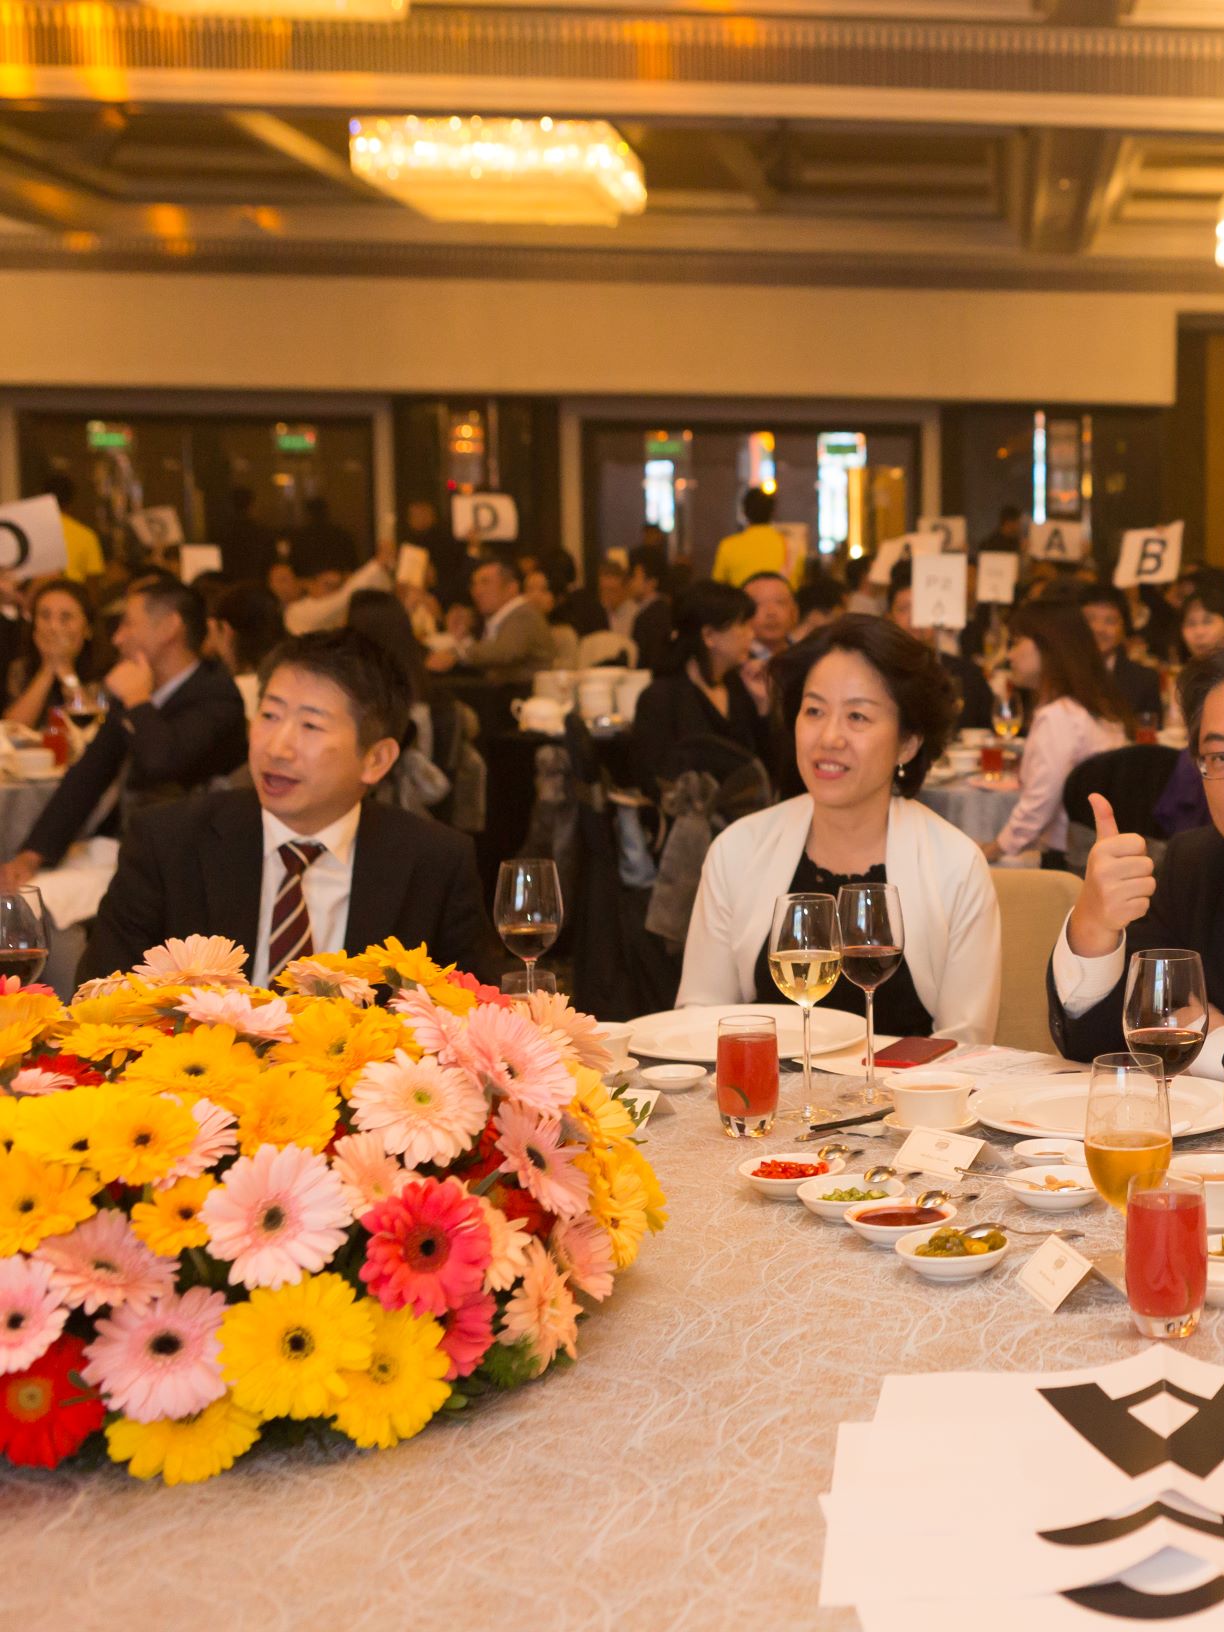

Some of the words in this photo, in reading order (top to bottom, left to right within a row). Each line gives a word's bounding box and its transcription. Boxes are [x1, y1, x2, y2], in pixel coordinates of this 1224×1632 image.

[473, 502, 499, 532] D
[1044, 527, 1067, 553] A
[1136, 538, 1167, 576] B
